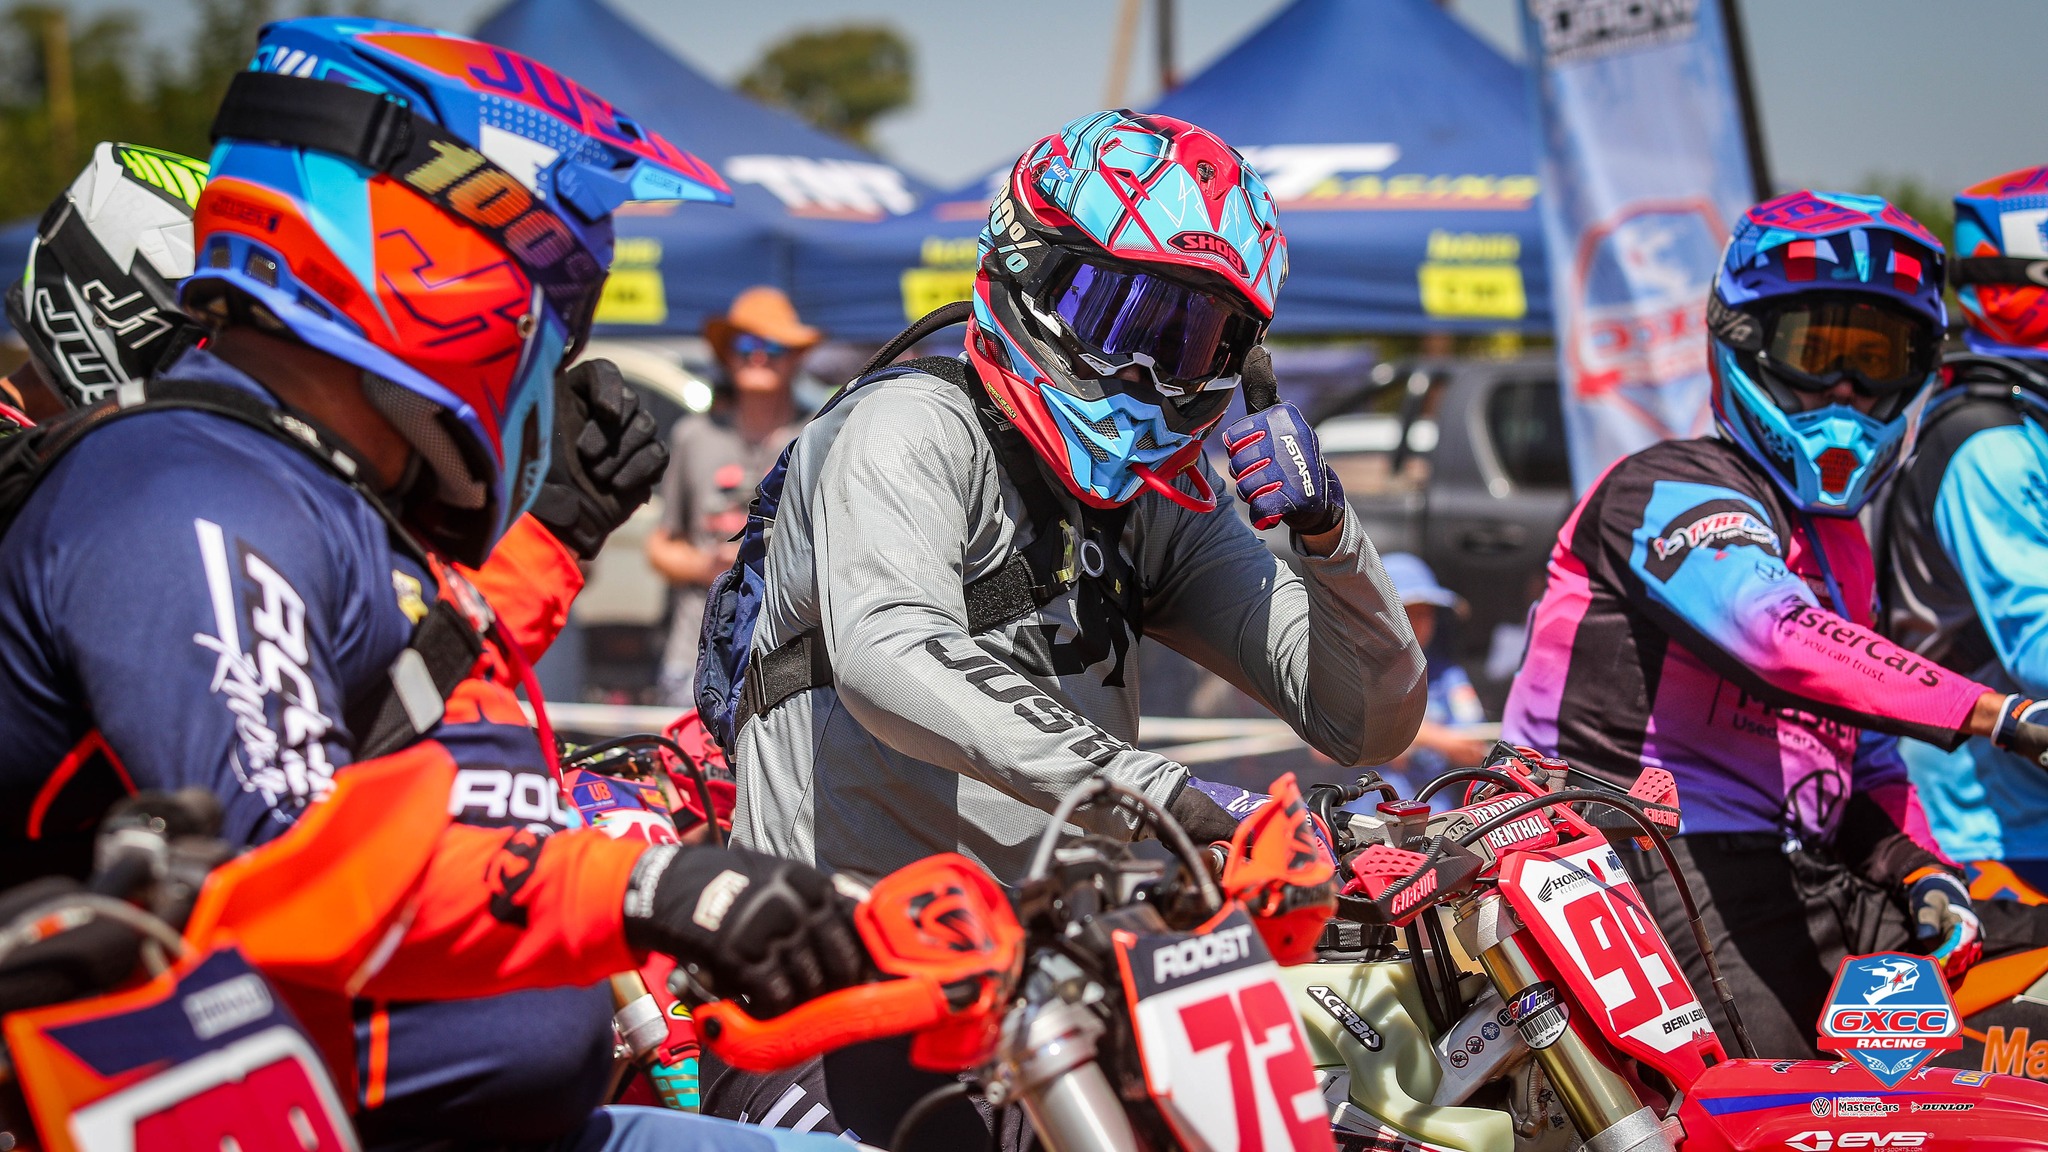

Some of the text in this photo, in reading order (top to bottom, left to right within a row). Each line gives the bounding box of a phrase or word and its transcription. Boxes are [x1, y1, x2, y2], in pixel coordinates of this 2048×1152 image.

[1182, 234, 1244, 271] SHOEI
[1279, 434, 1316, 499] ASTARS
[1827, 650, 1851, 667] can
[1487, 814, 1551, 849] RENTHAL
[1553, 869, 1591, 890] HONDA
[1153, 924, 1253, 984] ROOST
[1563, 882, 1695, 1034] 99
[1177, 979, 1337, 1152] 72
